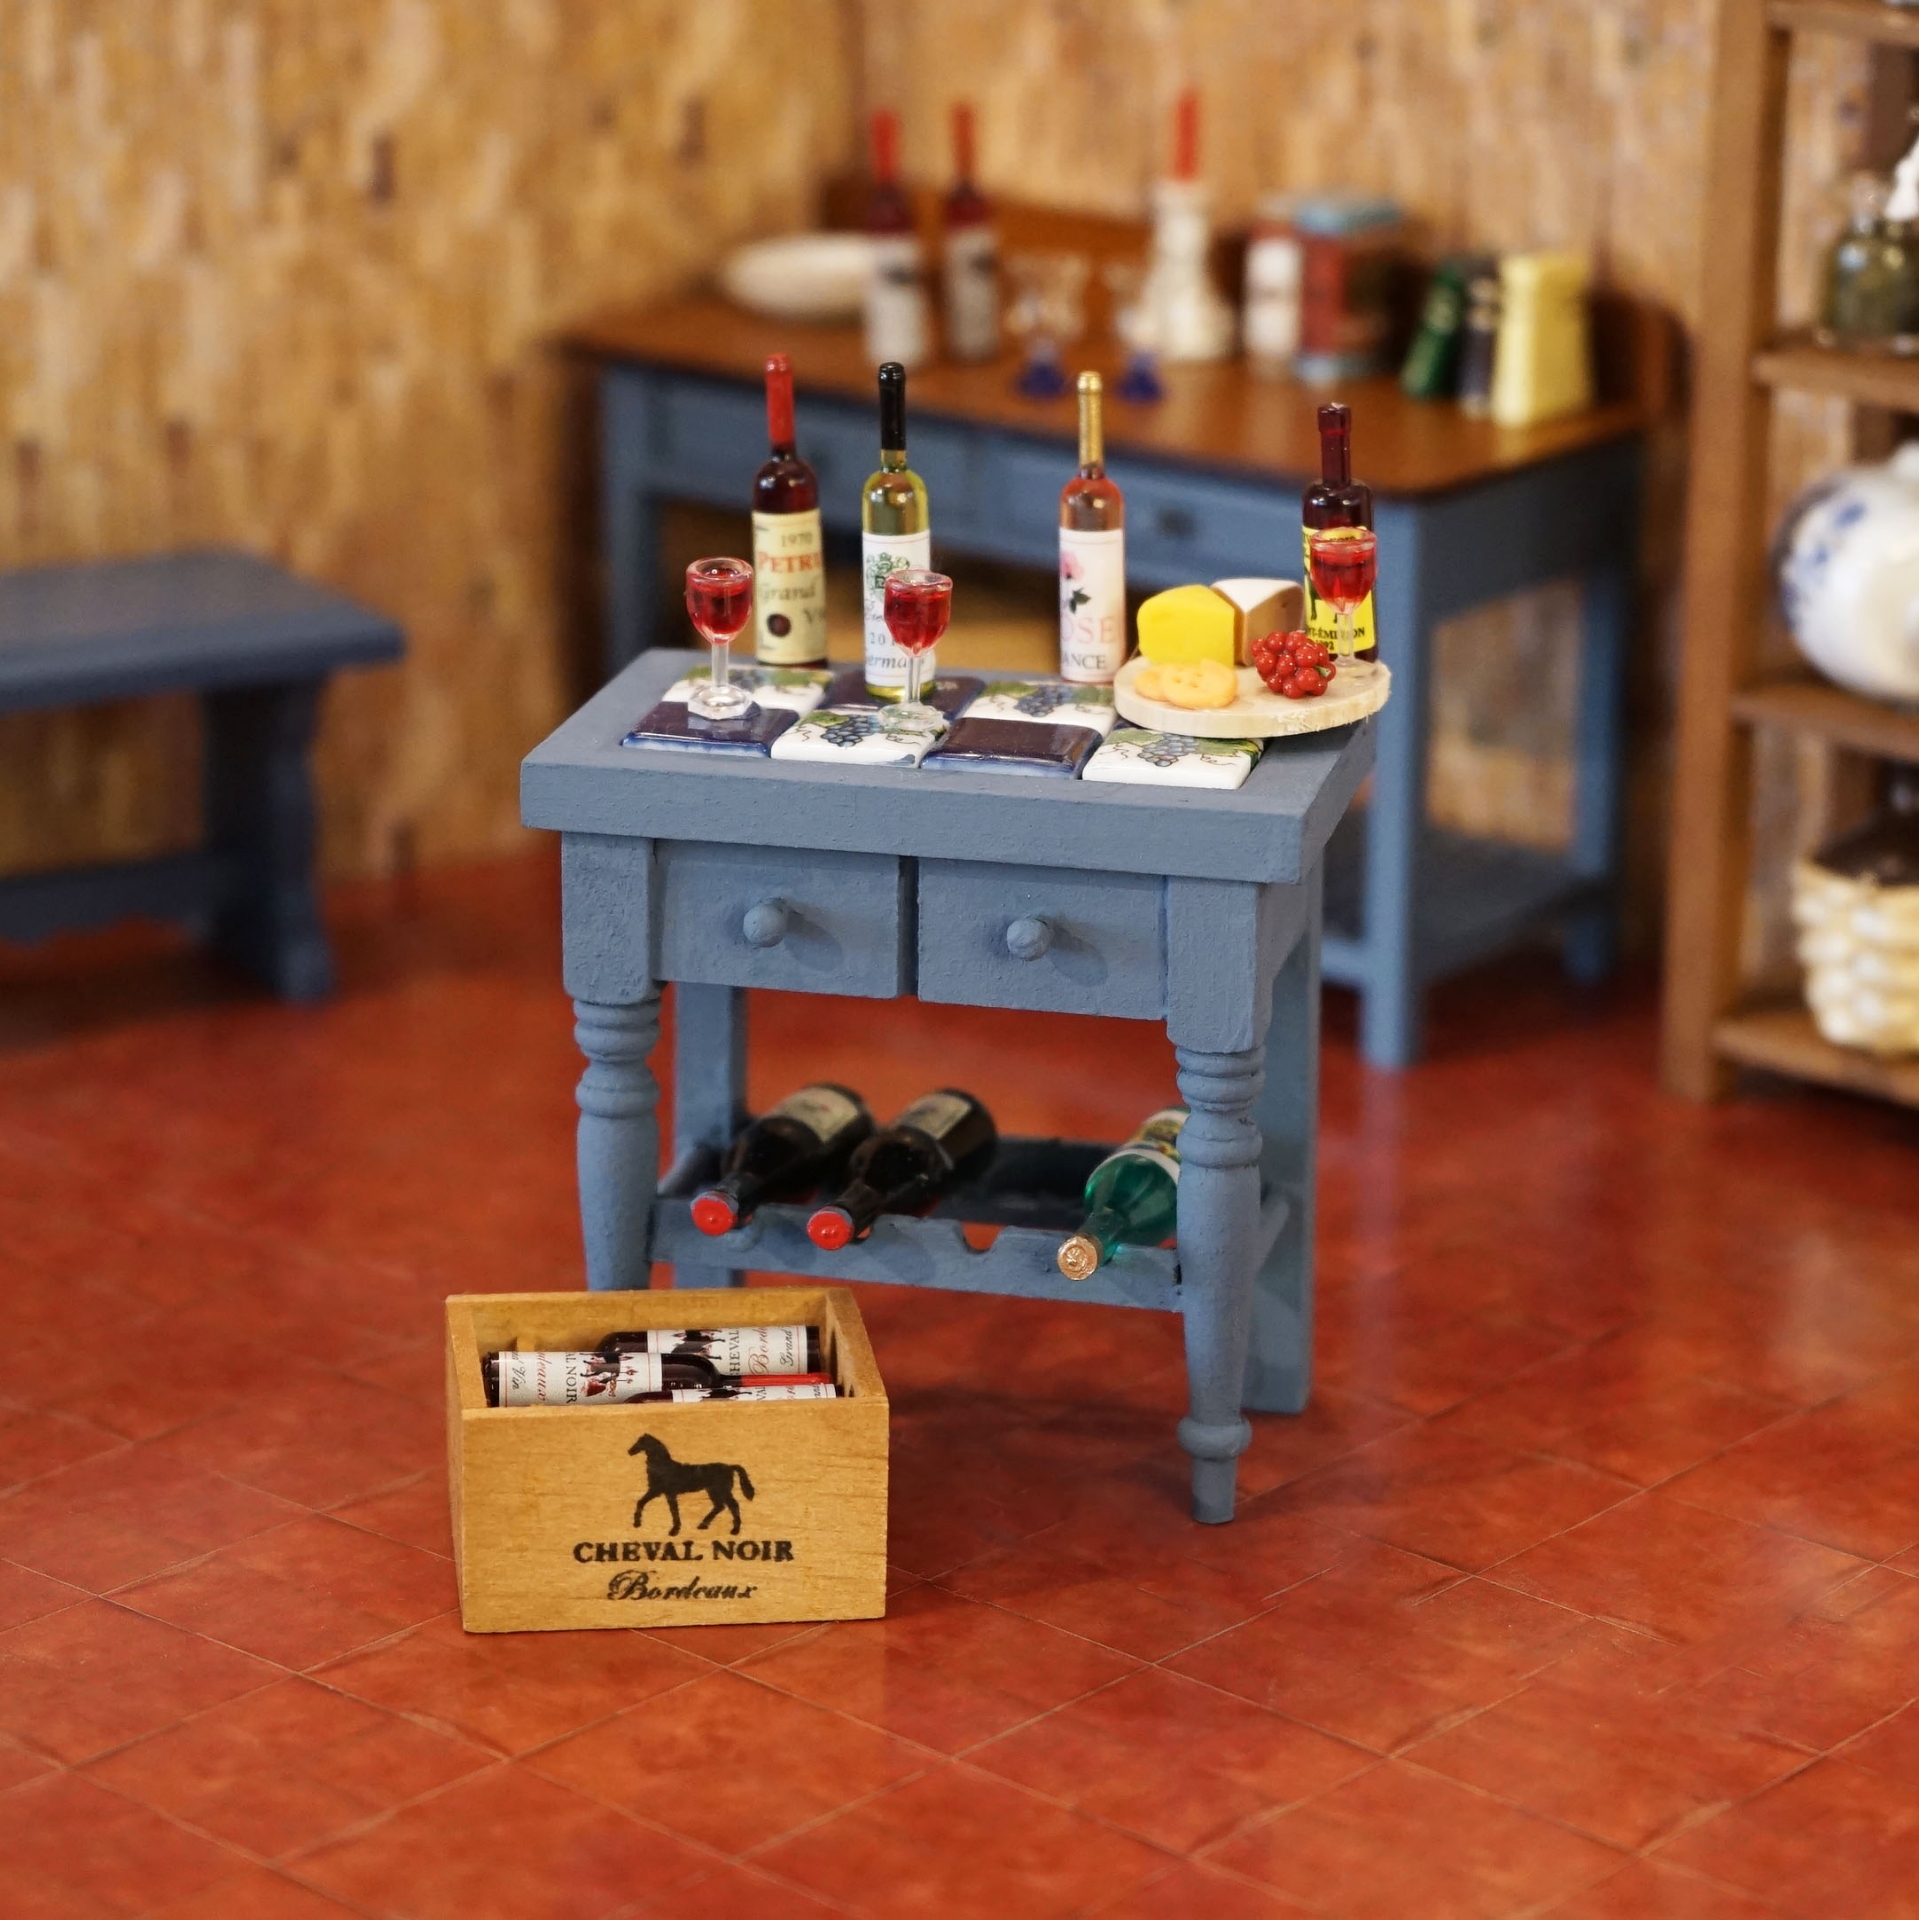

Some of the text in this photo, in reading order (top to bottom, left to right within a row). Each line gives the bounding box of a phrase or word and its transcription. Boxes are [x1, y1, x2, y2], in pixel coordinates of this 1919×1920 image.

[566, 1366, 578, 1404] NOIR
[573, 1540, 795, 1563] CHEVAL NOIR
[607, 1569, 758, 1600] Bordeaux
